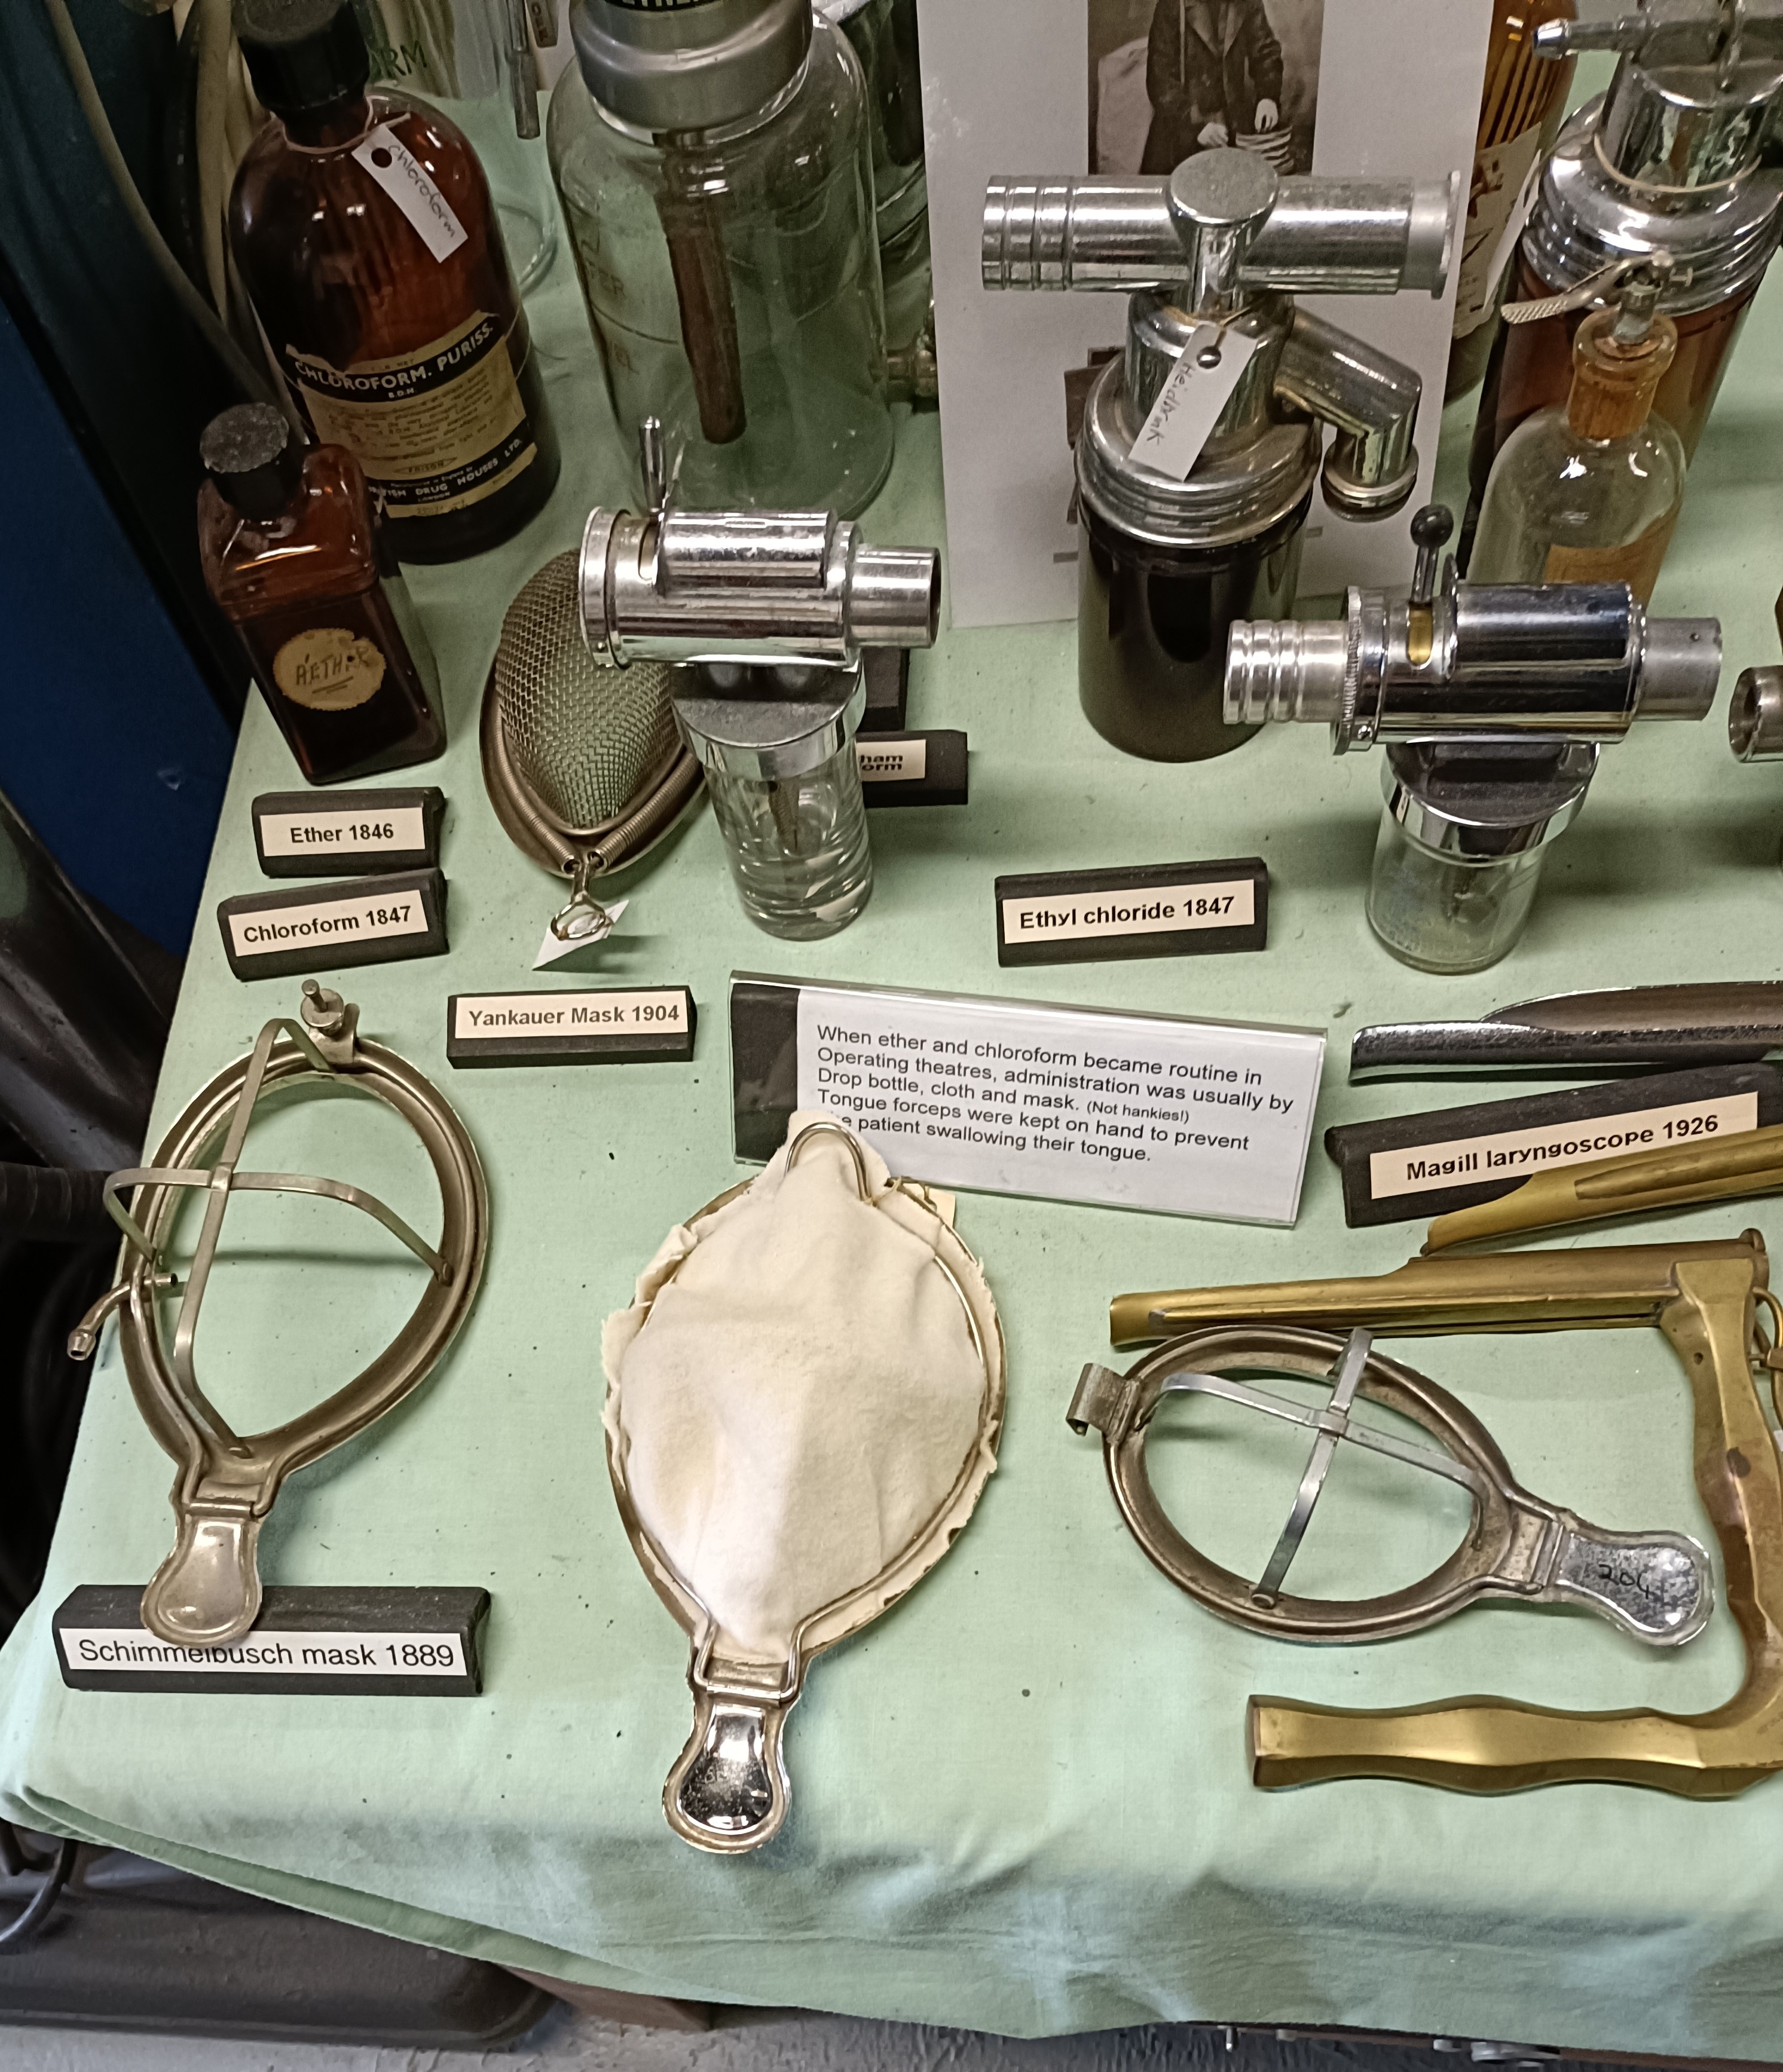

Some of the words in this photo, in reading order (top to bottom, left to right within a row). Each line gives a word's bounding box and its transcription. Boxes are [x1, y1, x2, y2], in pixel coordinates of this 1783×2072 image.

[295, 360, 432, 390] CHLOROFORM.
[437, 322, 493, 372] PURISS.
[415, 483, 448, 495] DRUG
[451, 458, 498, 485] HOUSES
[290, 827, 342, 843] Ether
[349, 822, 394, 840] 1846
[243, 915, 360, 942] Chloroform
[365, 905, 411, 926] 1847
[1020, 908, 1076, 929] Ethyl
[1084, 902, 1175, 925] chloride
[1183, 896, 1235, 917] 1847
[469, 1009, 565, 1026] Yankauer
[571, 1006, 625, 1023] Mask
[632, 1005, 680, 1022] 1904
[817, 1024, 871, 1045] When
[878, 1033, 926, 1051] ether
[932, 1040, 968, 1055] and
[974, 1042, 1076, 1066] chloroform
[1084, 1052, 1163, 1075] became
[1169, 1063, 1238, 1083] routine
[1244, 1068, 1262, 1085] in
[818, 1046, 909, 1074] Operating
[915, 1058, 997, 1083] theatres,
[1004, 1068, 1139, 1095] administration
[1146, 1084, 1186, 1100] was
[1193, 1089, 1264, 1112] usually
[1269, 1094, 1294, 1114] by
[818, 1067, 862, 1089] Drop
[868, 1073, 924, 1095] bottle,
[931, 1081, 975, 1100] cloth
[981, 1089, 1017, 1104] and
[1023, 1094, 1079, 1111] mask.
[1086, 1100, 1117, 1115] (Not
[1123, 1103, 1189, 1125] hankies!)
[817, 1088, 887, 1112] Tongue
[893, 1097, 961, 1119] forceps
[968, 1108, 1013, 1125] were
[1020, 1112, 1060, 1131] kept
[1065, 1119, 1089, 1133] on
[1096, 1119, 1144, 1140] hand
[1151, 1126, 1168, 1141] to
[1175, 1131, 1249, 1151] prevent
[858, 1116, 920, 1134] patient
[926, 1124, 1026, 1151] swallowing
[1033, 1135, 1075, 1152] their
[1080, 1139, 1151, 1162] tongue.
[1406, 1153, 1478, 1180] Magill
[1487, 1128, 1654, 1167] laryngoscope
[1662, 1114, 1719, 1140] 1926
[79, 1639, 293, 1666] Schimmelbusch
[302, 1644, 377, 1666] mask
[386, 1643, 454, 1667] 1889
